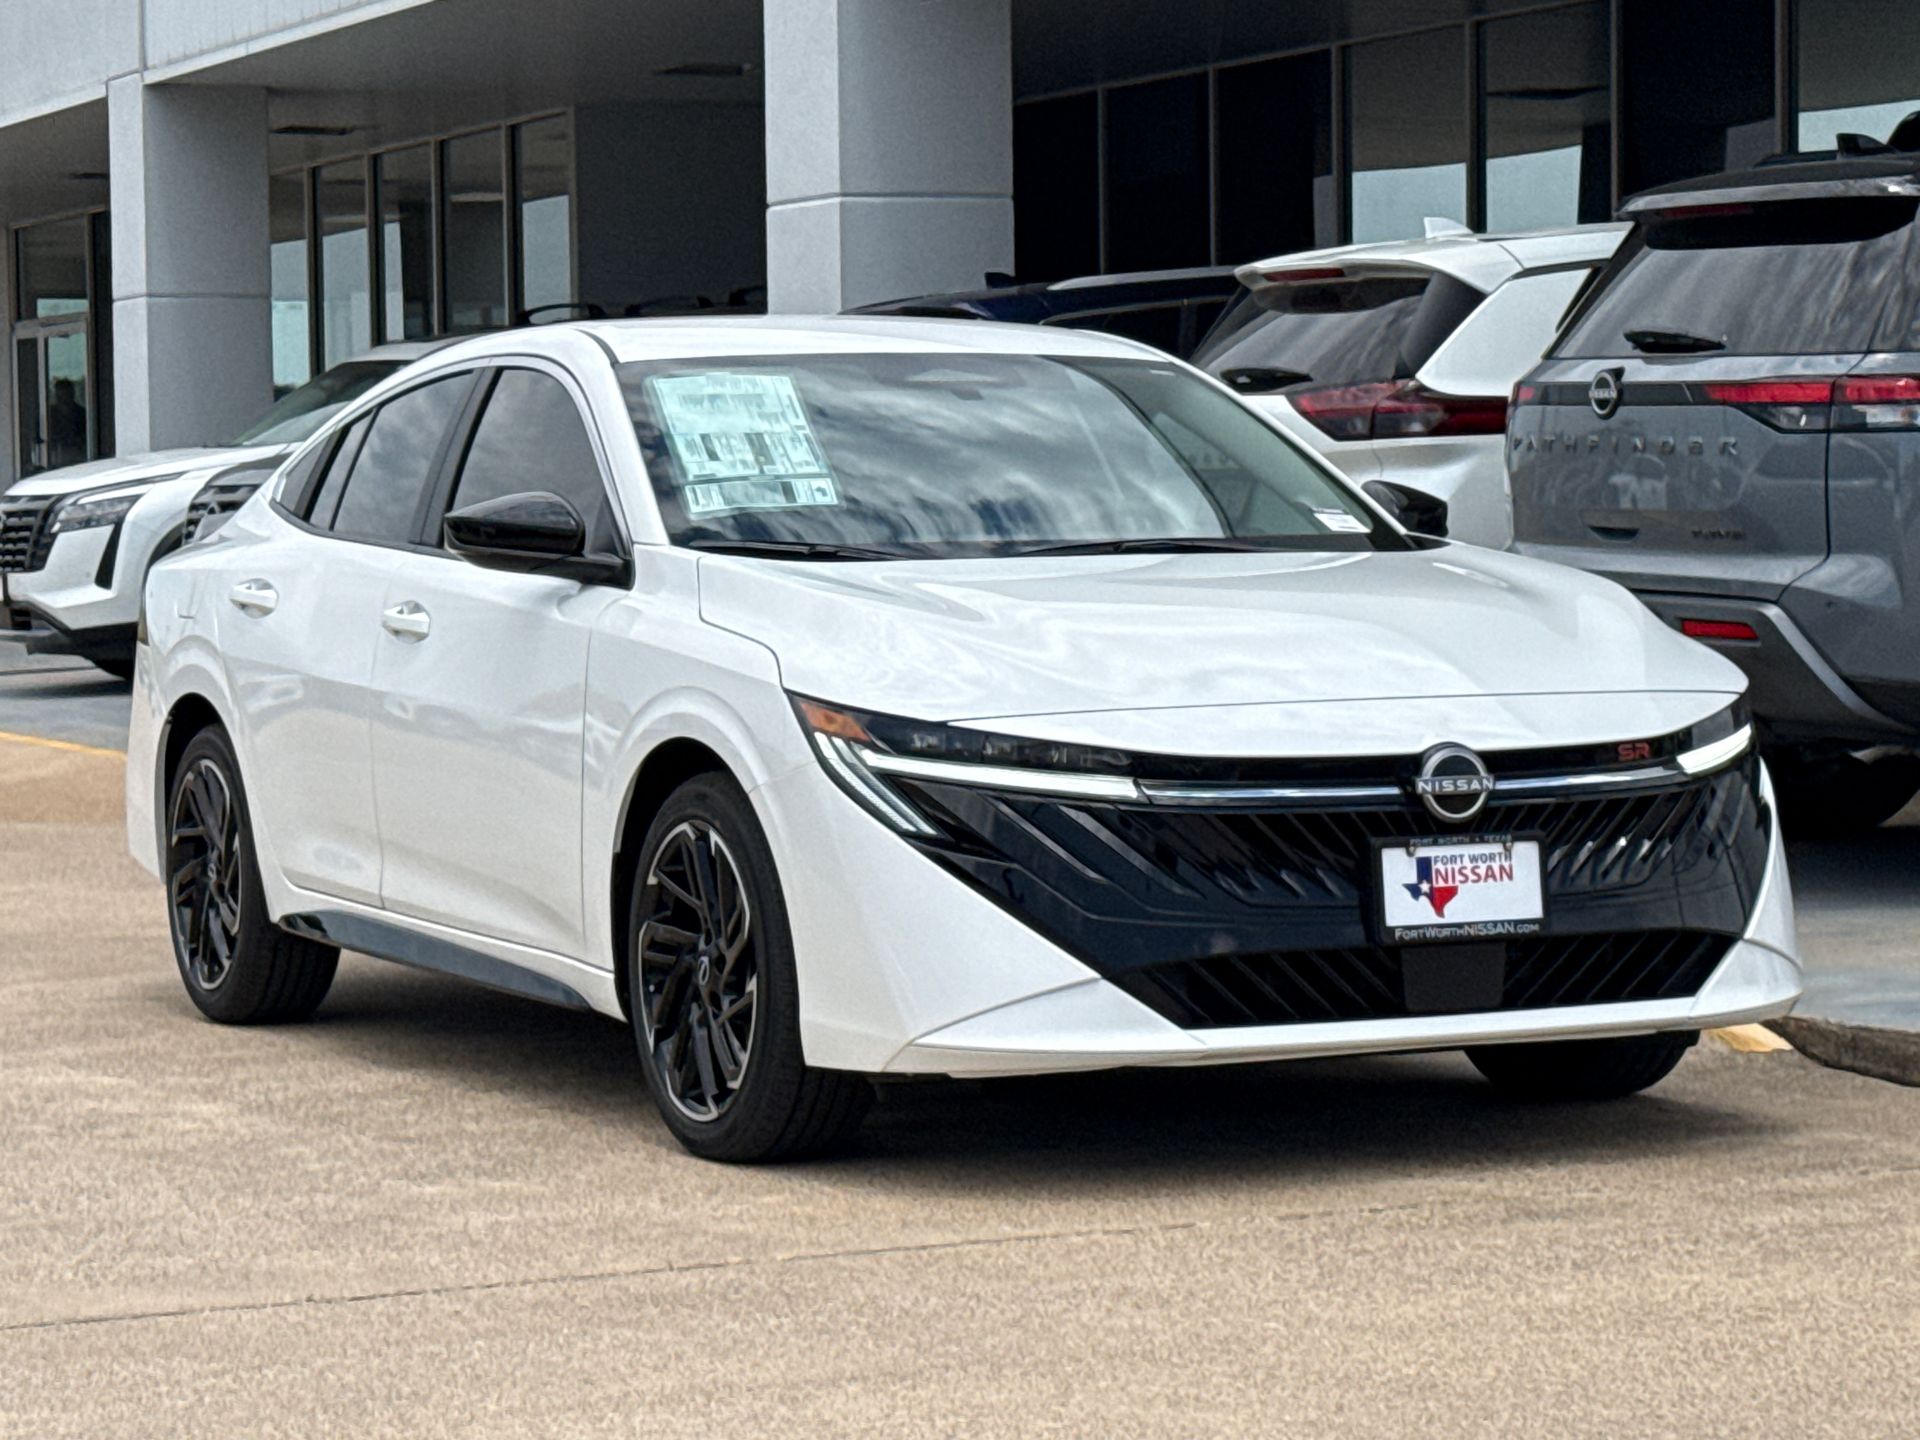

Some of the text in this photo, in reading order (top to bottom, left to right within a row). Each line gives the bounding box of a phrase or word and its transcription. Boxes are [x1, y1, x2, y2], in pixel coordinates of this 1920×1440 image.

[1513, 435, 1738, 455] PATHFINDER
[1617, 742, 1650, 761] SR
[1418, 778, 1494, 792] NISSAN
[1434, 851, 1513, 866] FORT WORTH
[1434, 864, 1514, 885] NISSAN
